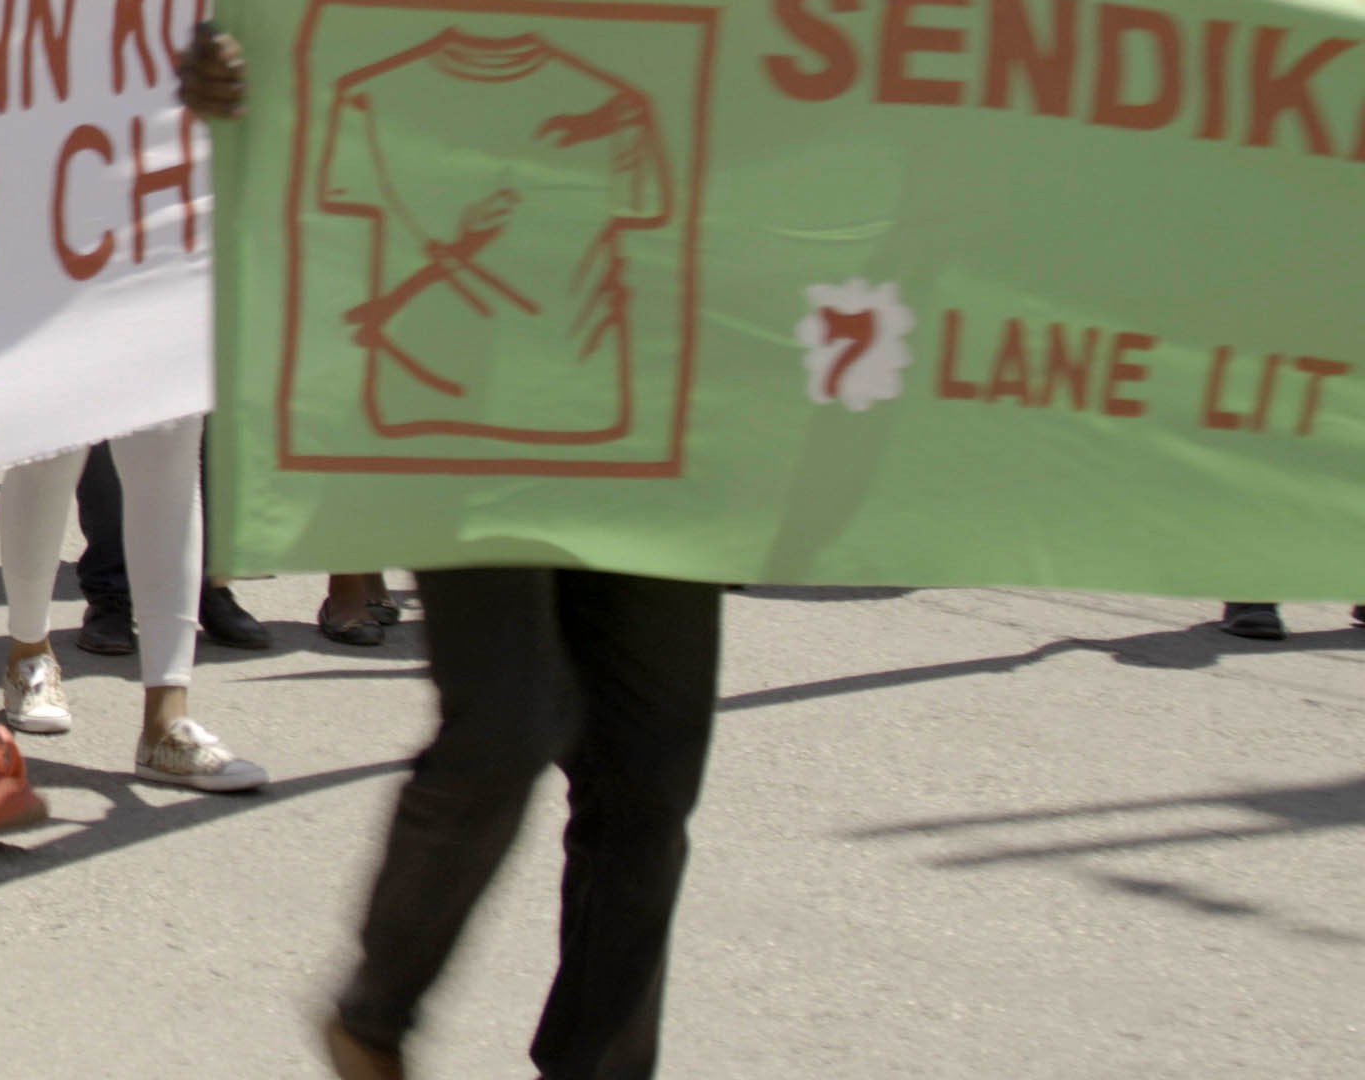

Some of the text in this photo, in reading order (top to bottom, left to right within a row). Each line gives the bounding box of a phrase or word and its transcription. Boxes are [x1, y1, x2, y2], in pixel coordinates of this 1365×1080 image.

[817, 305, 1355, 438] 7 LANE LIT
